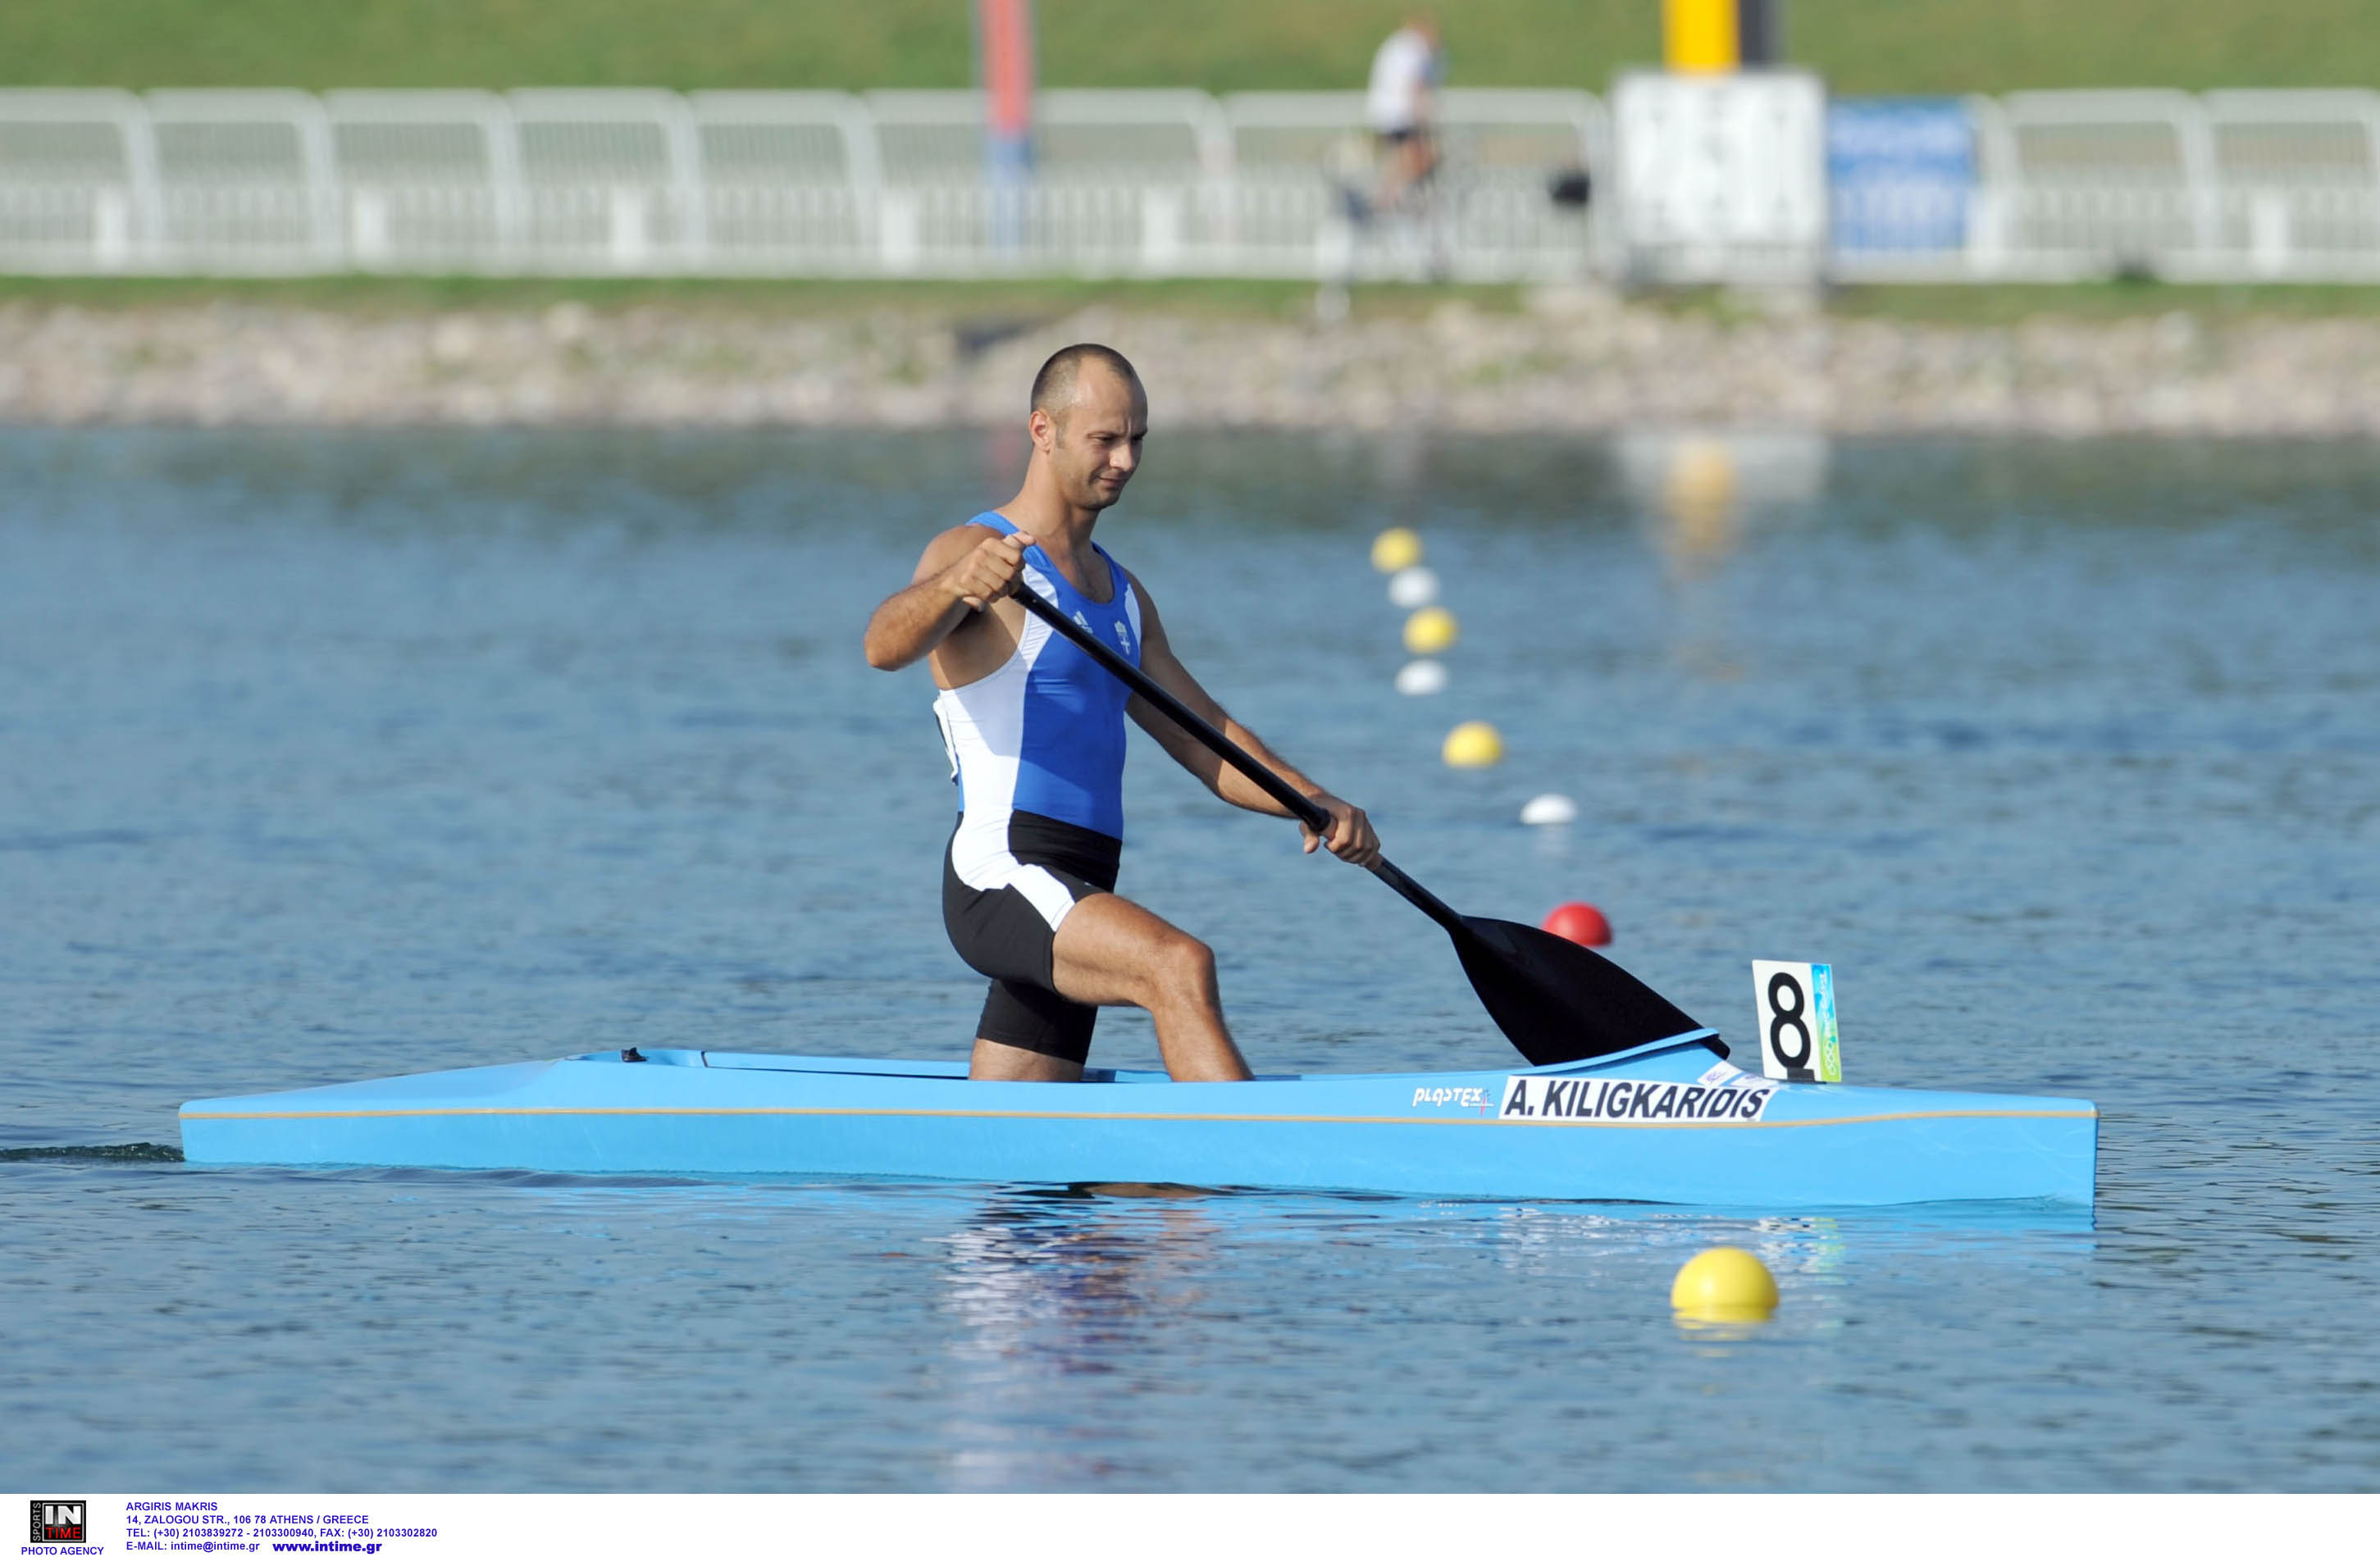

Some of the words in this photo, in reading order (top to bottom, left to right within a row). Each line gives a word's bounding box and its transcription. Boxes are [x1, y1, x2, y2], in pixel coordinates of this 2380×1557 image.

[1767, 972, 1812, 1070] 8
[1504, 1080, 1534, 1116] A.
[1542, 1080, 1770, 1118] KILIGKARIDIS
